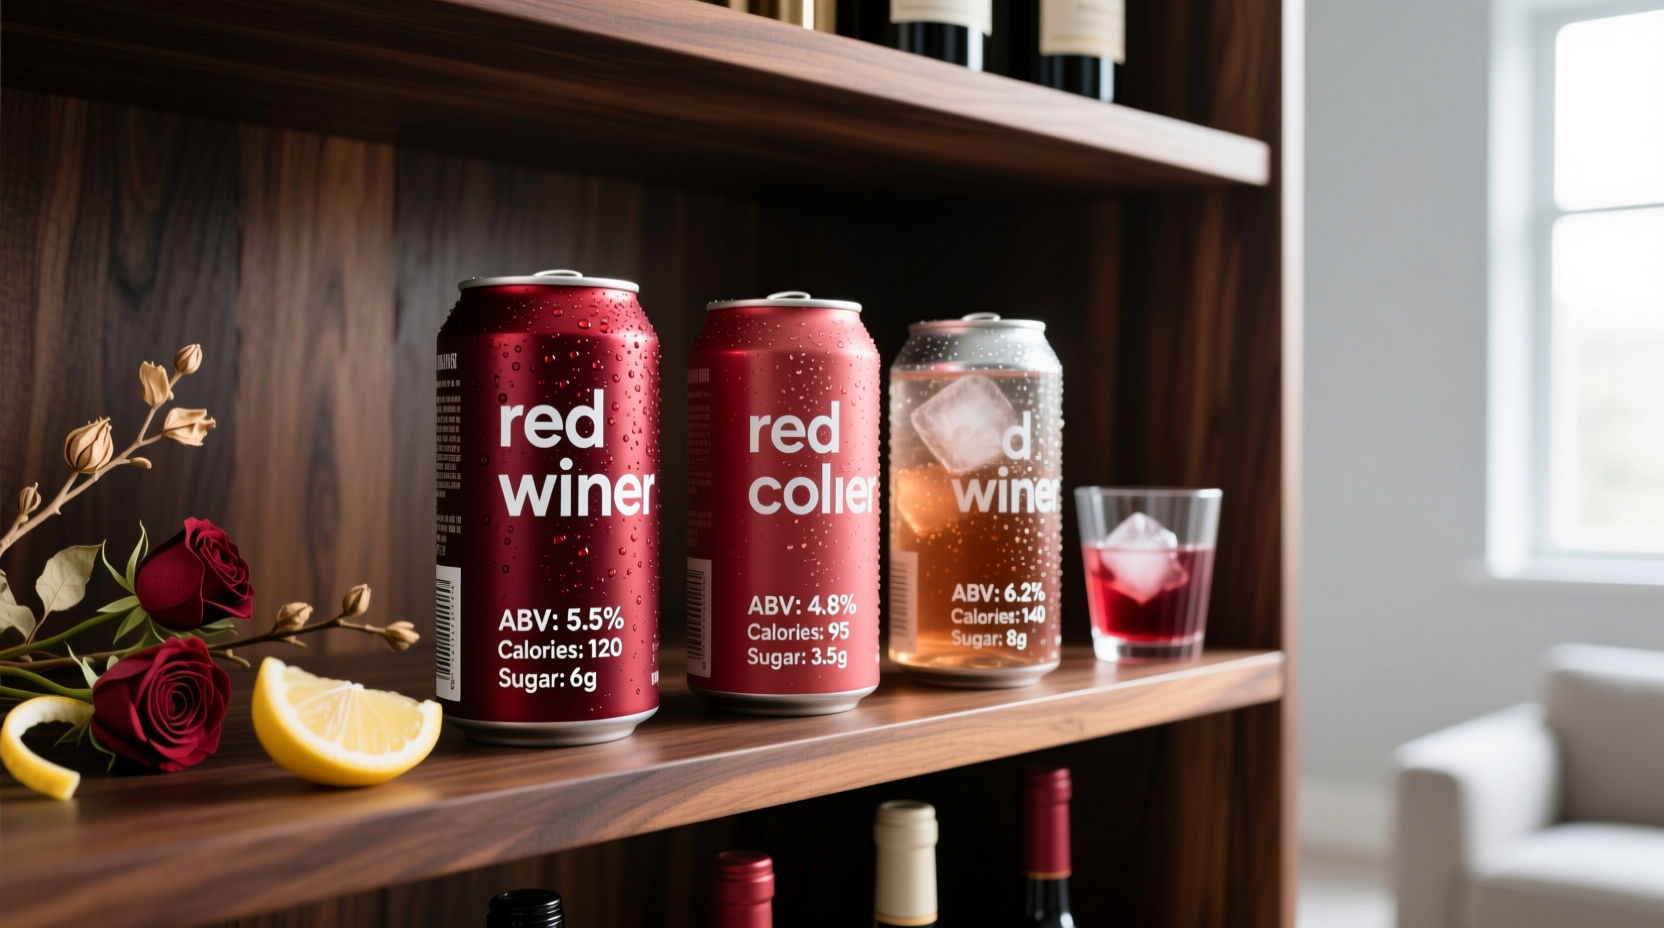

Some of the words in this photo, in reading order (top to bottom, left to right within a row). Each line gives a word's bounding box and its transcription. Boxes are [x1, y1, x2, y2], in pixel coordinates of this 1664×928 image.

[500, 388, 605, 449] red
[749, 400, 840, 454] red
[498, 457, 655, 517] winer
[951, 583, 1000, 602] ABV:
[1004, 581, 1046, 602] 6.2%
[747, 595, 802, 616] ABV:
[807, 592, 857, 616] 4.8%
[951, 607, 1020, 625] Calories:
[1021, 604, 1046, 624] 140
[498, 608, 559, 632] ABV:
[566, 605, 625, 631] 5.5%
[747, 622, 824, 641] Calories:
[828, 621, 850, 641] 95
[951, 628, 1003, 650] Sugar:
[1006, 628, 1027, 651] 8g
[497, 639, 584, 660] Calories:
[588, 637, 623, 659] 120
[747, 647, 806, 670] Sugar:
[811, 646, 848, 669] 3.5g
[498, 667, 565, 694] Sugar:
[569, 666, 597, 693] 6g
